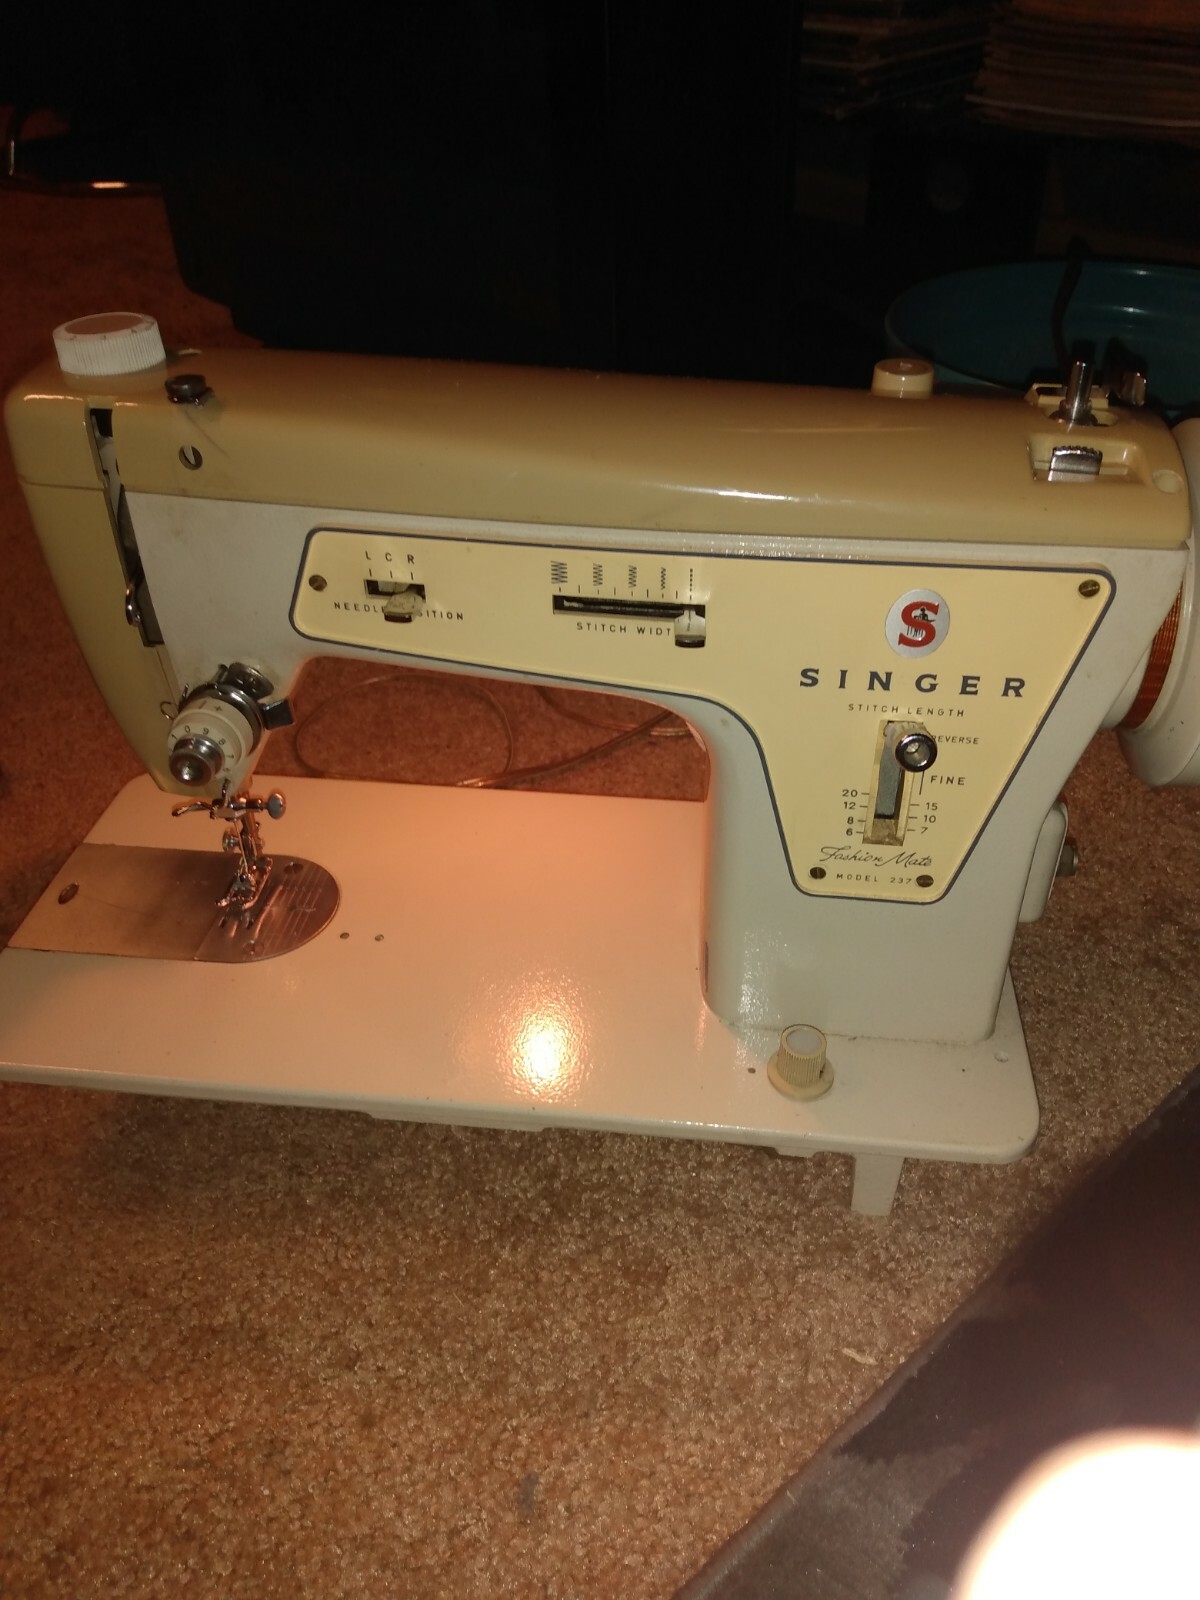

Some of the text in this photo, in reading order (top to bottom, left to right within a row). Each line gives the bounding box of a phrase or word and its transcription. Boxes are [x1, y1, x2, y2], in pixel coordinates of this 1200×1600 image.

[365, 550, 414, 564] L C R
[577, 622, 671, 636] STITCH WIDT
[898, 600, 939, 647] S
[799, 668, 1025, 698] SINGER
[848, 703, 965, 717] STITCH LENGTH
[930, 775, 966, 786] FINE
[842, 789, 858, 797] 20
[843, 801, 856, 809] 12
[926, 802, 938, 810] 15
[847, 816, 854, 825] 8
[923, 815, 936, 823] 10
[846, 827, 853, 836] 6
[819, 845, 932, 868] Fashion Mate
[836, 873, 912, 884] MODEL 237
